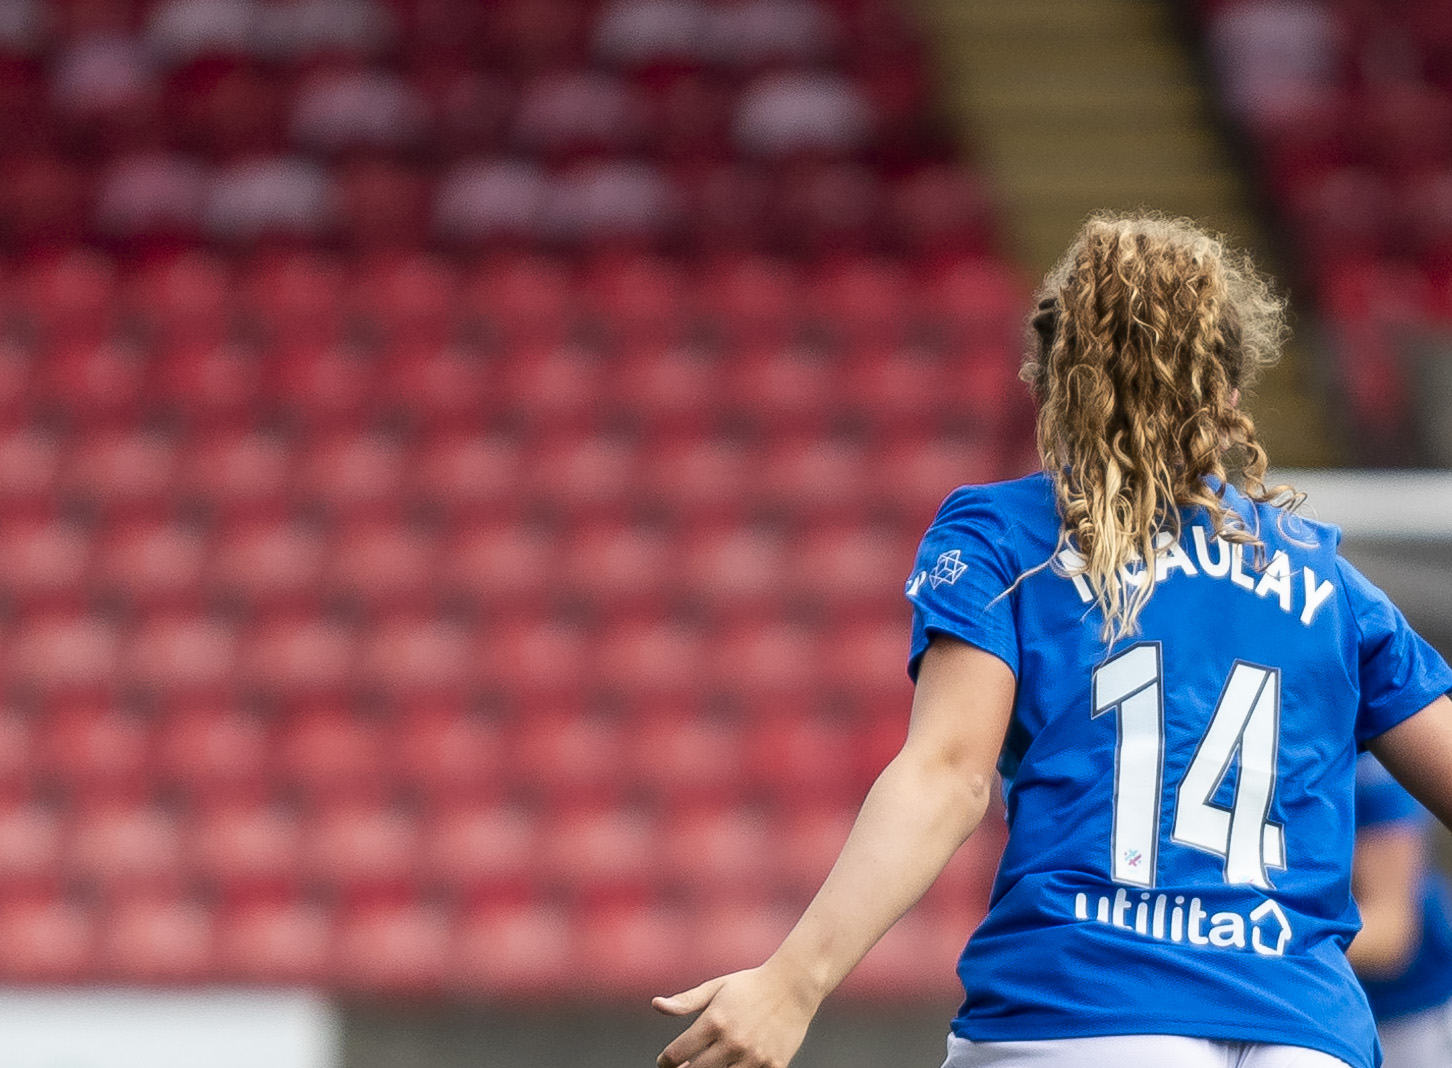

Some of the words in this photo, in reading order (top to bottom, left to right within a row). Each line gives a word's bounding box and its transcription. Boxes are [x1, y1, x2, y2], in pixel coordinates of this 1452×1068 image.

[1058, 524, 1334, 625] AULAY
[1091, 640, 1286, 889] 14
[1075, 888, 1246, 948] utilita
